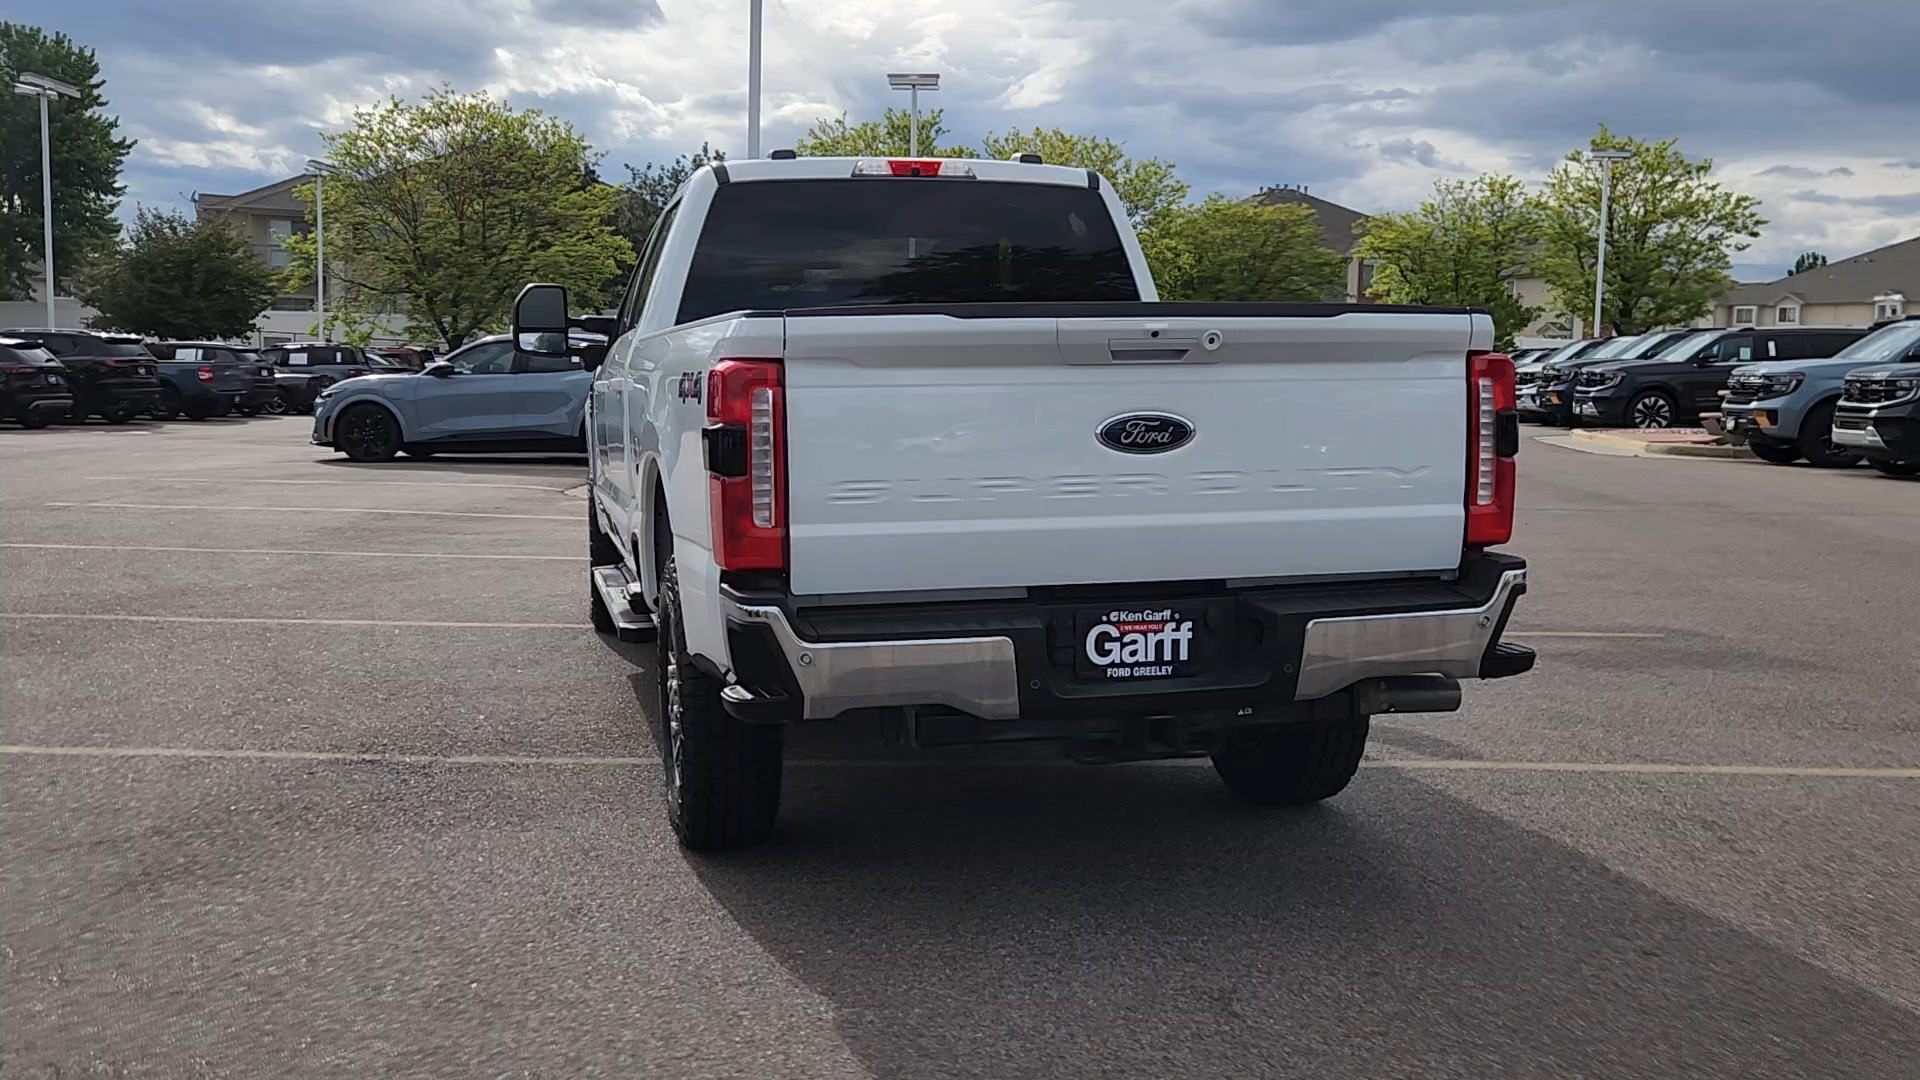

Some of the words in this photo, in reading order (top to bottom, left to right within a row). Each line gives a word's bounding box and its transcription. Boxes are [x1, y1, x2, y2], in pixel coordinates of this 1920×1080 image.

[1120, 420, 1174, 444] Ford
[827, 472, 1168, 504] SUPER
[1188, 465, 1432, 495] DUTY
[1120, 611, 1142, 622] Ken
[1143, 609, 1171, 621] Garff
[1086, 621, 1193, 665] Garff
[1107, 667, 1131, 678] FORD
[1133, 665, 1173, 677] GREELEY
